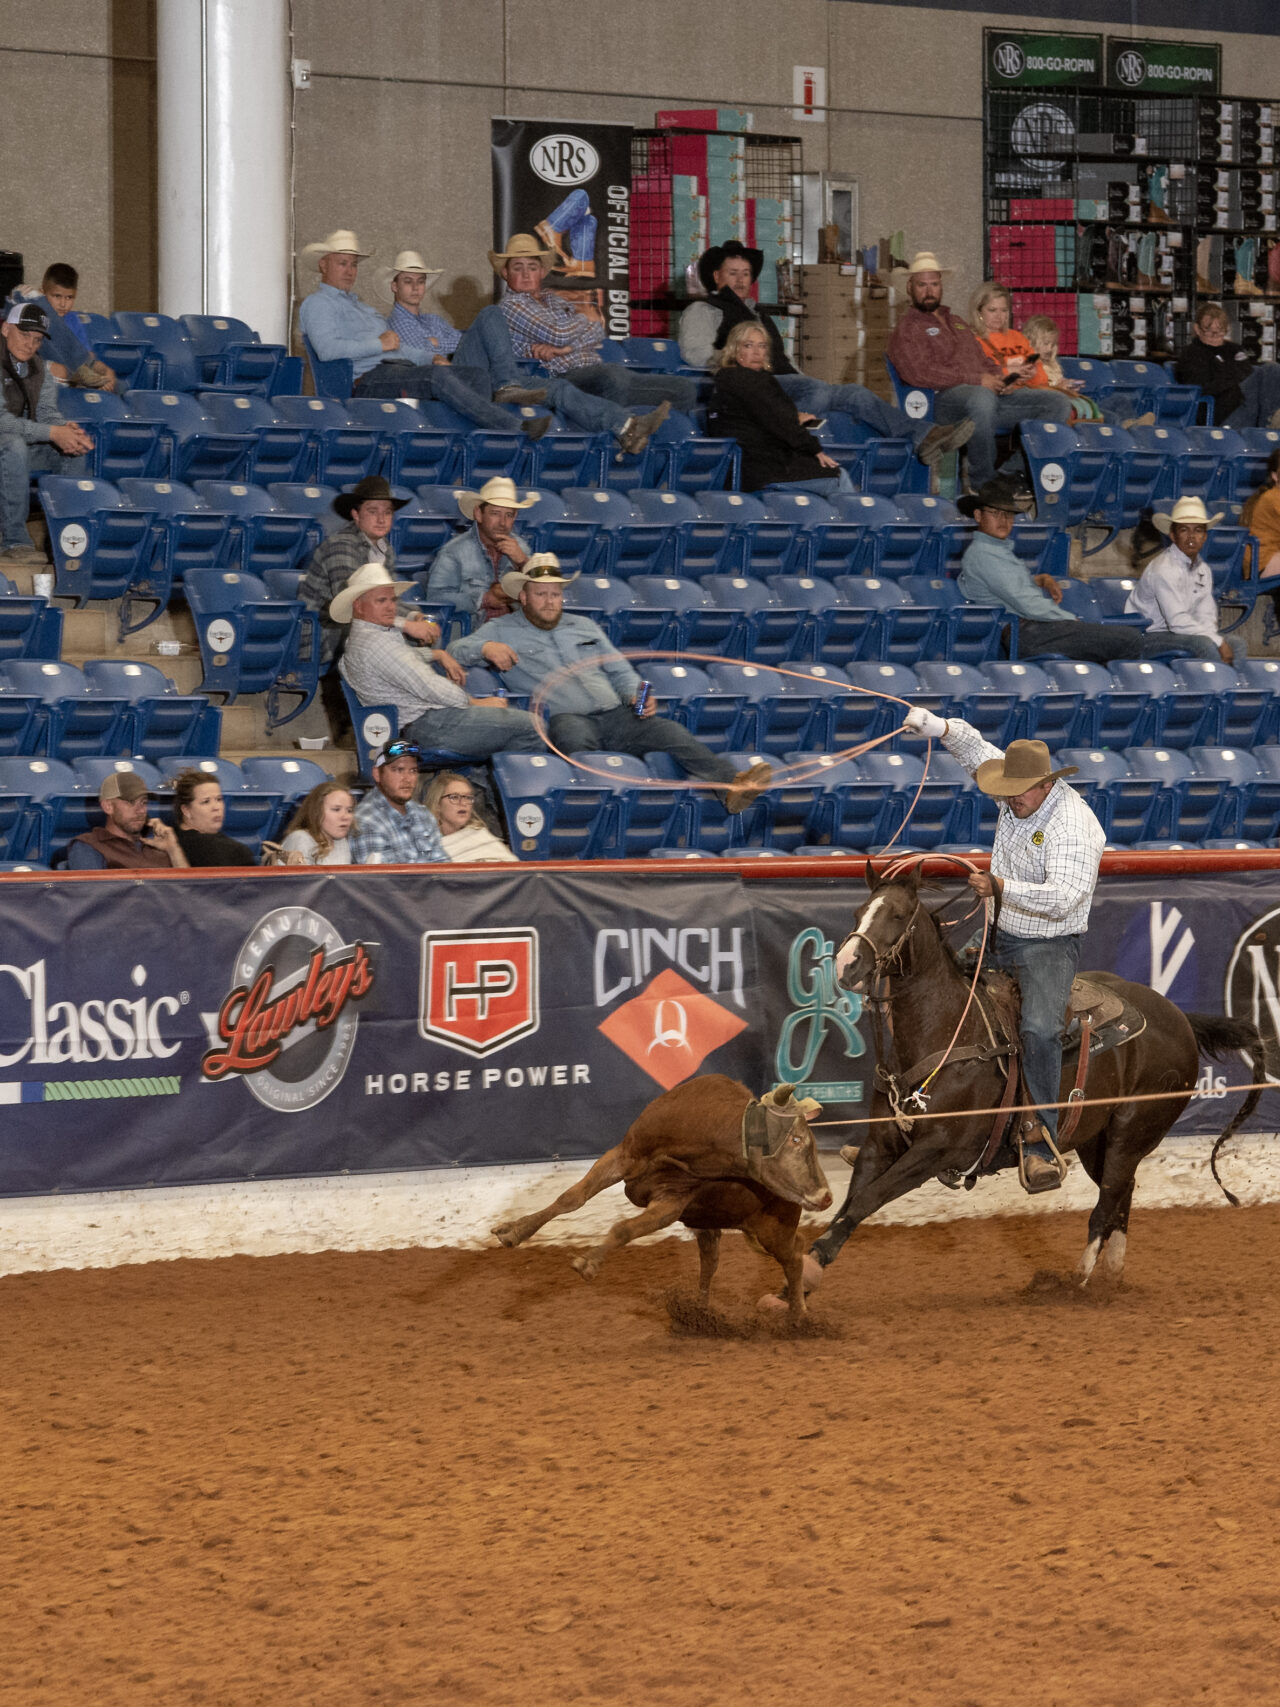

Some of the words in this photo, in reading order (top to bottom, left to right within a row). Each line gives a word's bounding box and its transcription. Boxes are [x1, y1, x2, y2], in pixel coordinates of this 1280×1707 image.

[998, 45, 1021, 74] NRS
[1026, 55, 1095, 73] 800-GO-ROPIN
[1120, 54, 1142, 82] NRS
[1147, 64, 1213, 82] 800-GO-ROPIN
[541, 140, 586, 178] NRS
[607, 185, 630, 281] OFFICIAL
[445, 959, 518, 1022] HP
[595, 927, 747, 1009] CINCH
[203, 945, 375, 1076] Lawley's
[365, 1069, 472, 1096] HORSE
[482, 1063, 592, 1090] POWER
